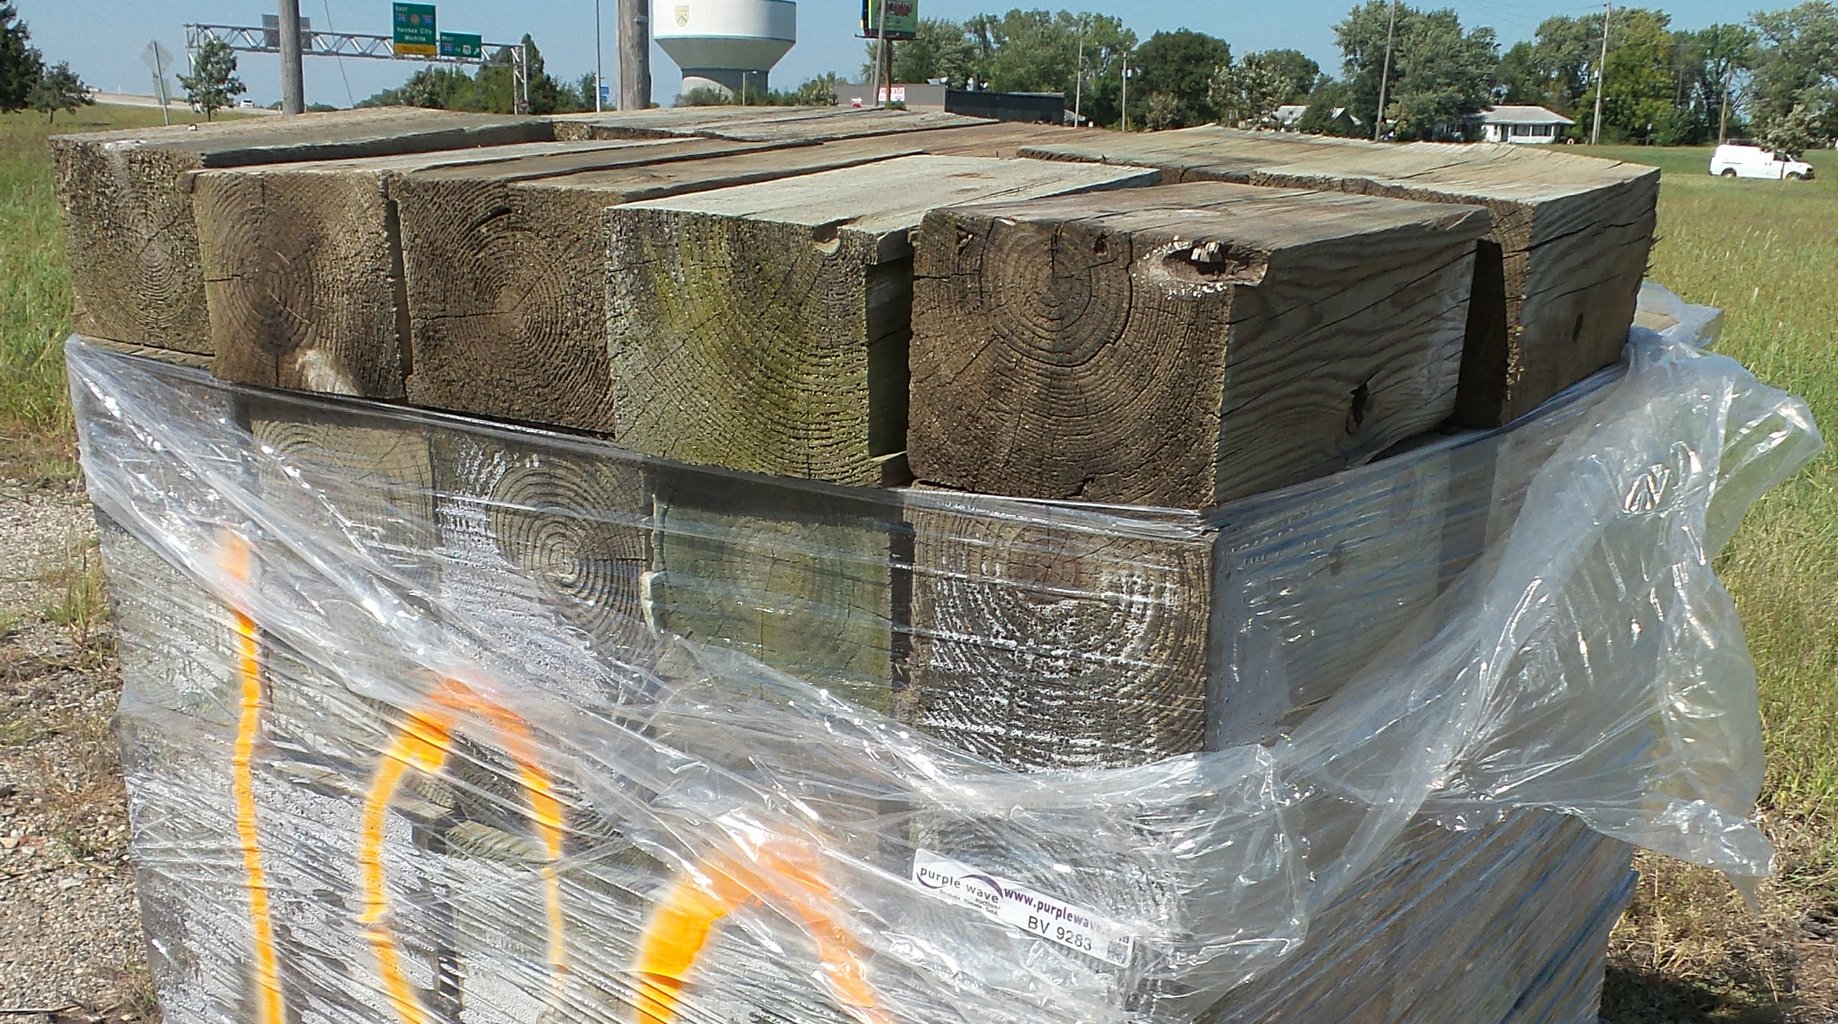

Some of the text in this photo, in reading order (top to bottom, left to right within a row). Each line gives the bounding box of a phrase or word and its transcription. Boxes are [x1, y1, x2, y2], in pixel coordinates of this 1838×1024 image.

[920, 867, 961, 889] purple
[966, 884, 999, 904] wave
[1028, 915, 1092, 951] BV 9283
